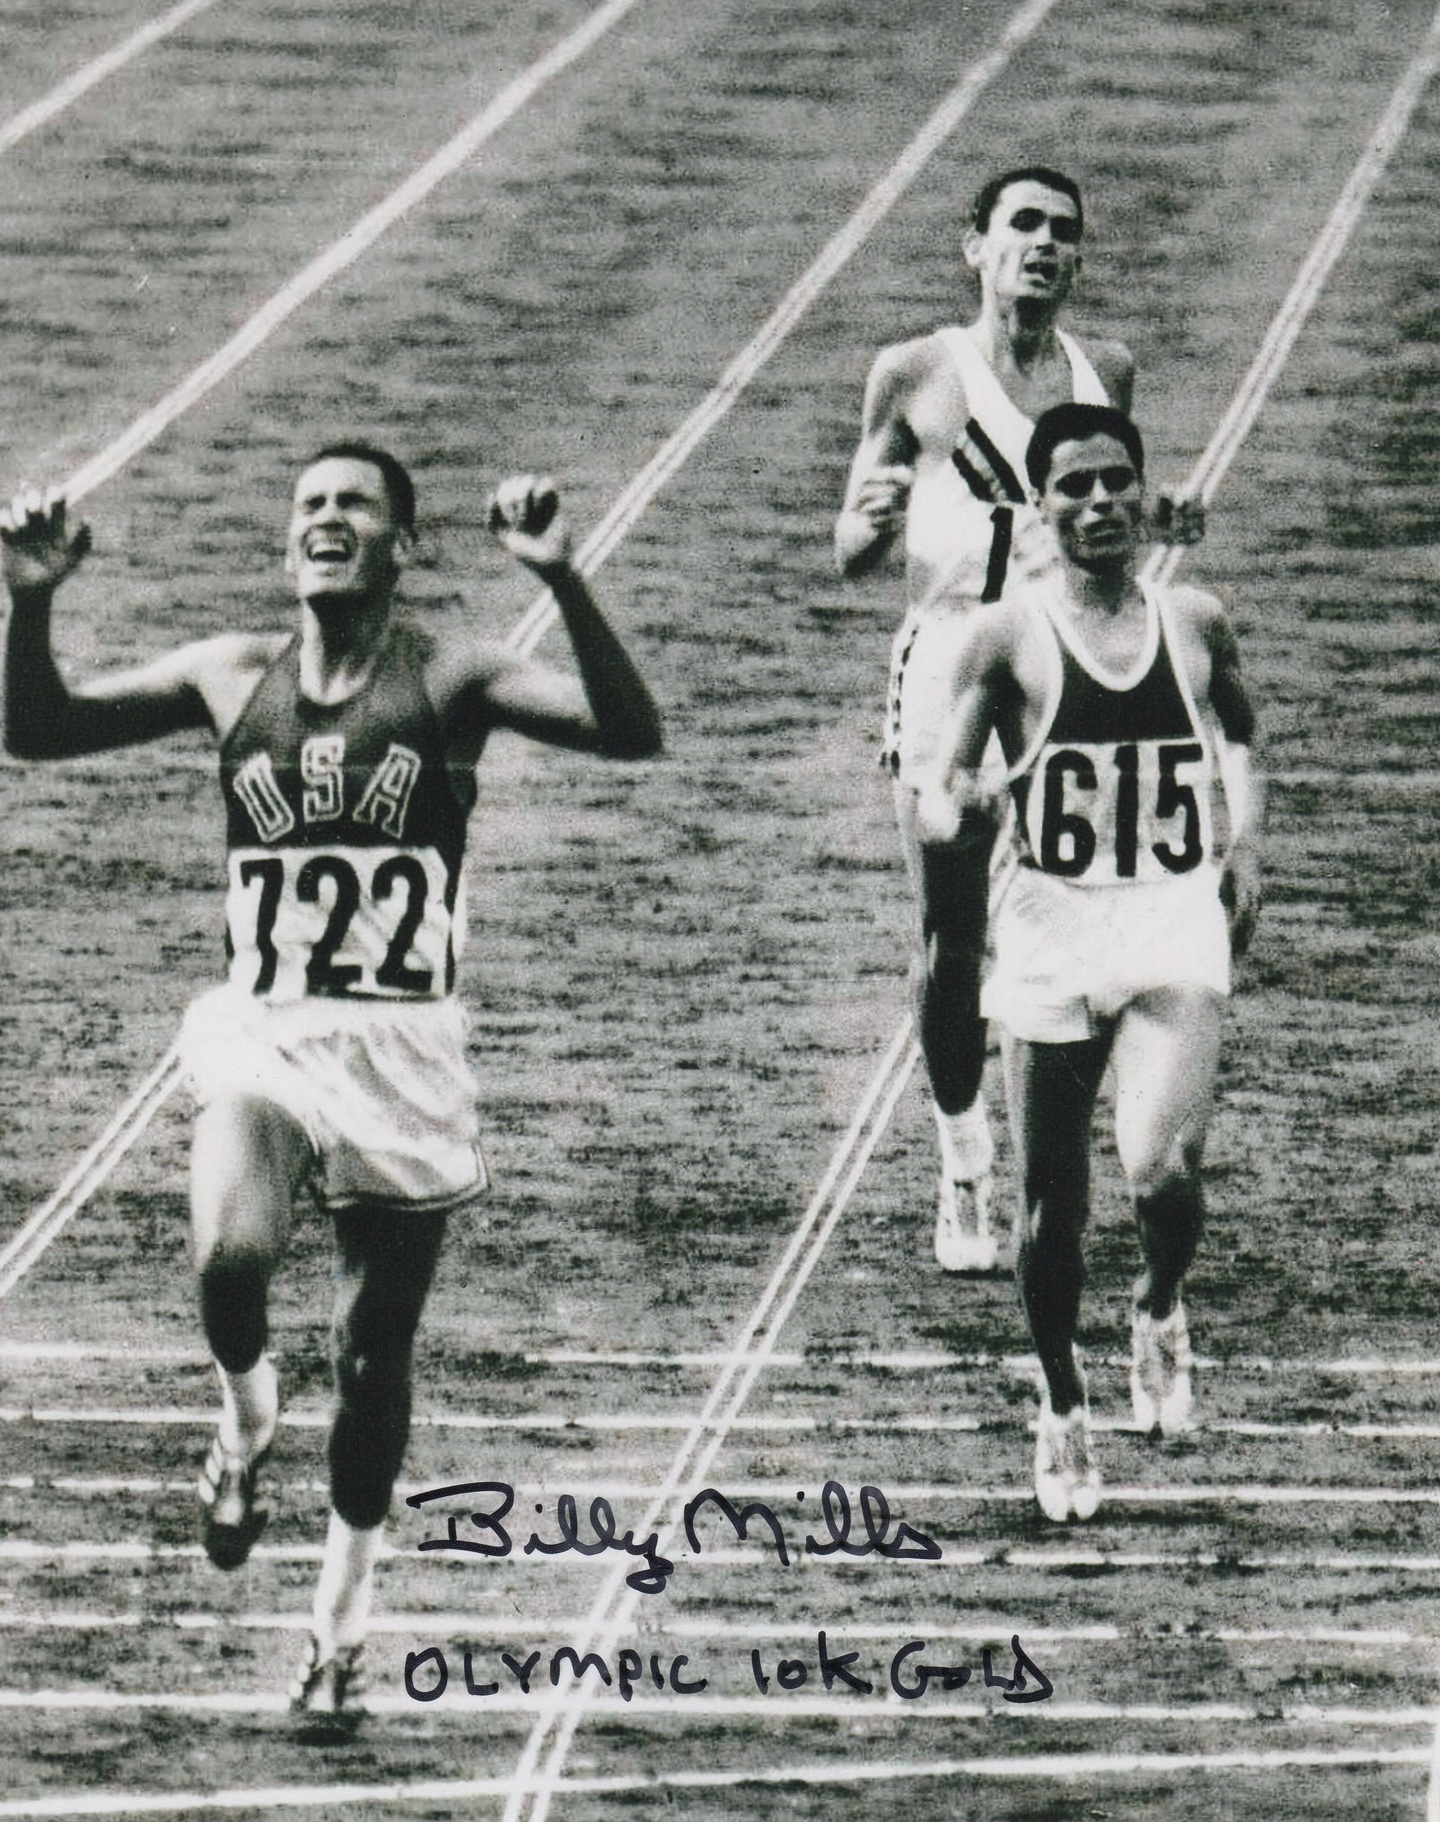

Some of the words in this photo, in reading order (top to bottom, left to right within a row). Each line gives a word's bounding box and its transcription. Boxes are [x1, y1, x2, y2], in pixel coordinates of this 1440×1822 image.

[233, 735, 421, 843] USA
[1041, 744, 1202, 877] 615
[240, 855, 433, 997] 722
[406, 1481, 674, 1594] Billy
[684, 1480, 943, 1566] Mills
[405, 1646, 708, 1701] OLYMPIC
